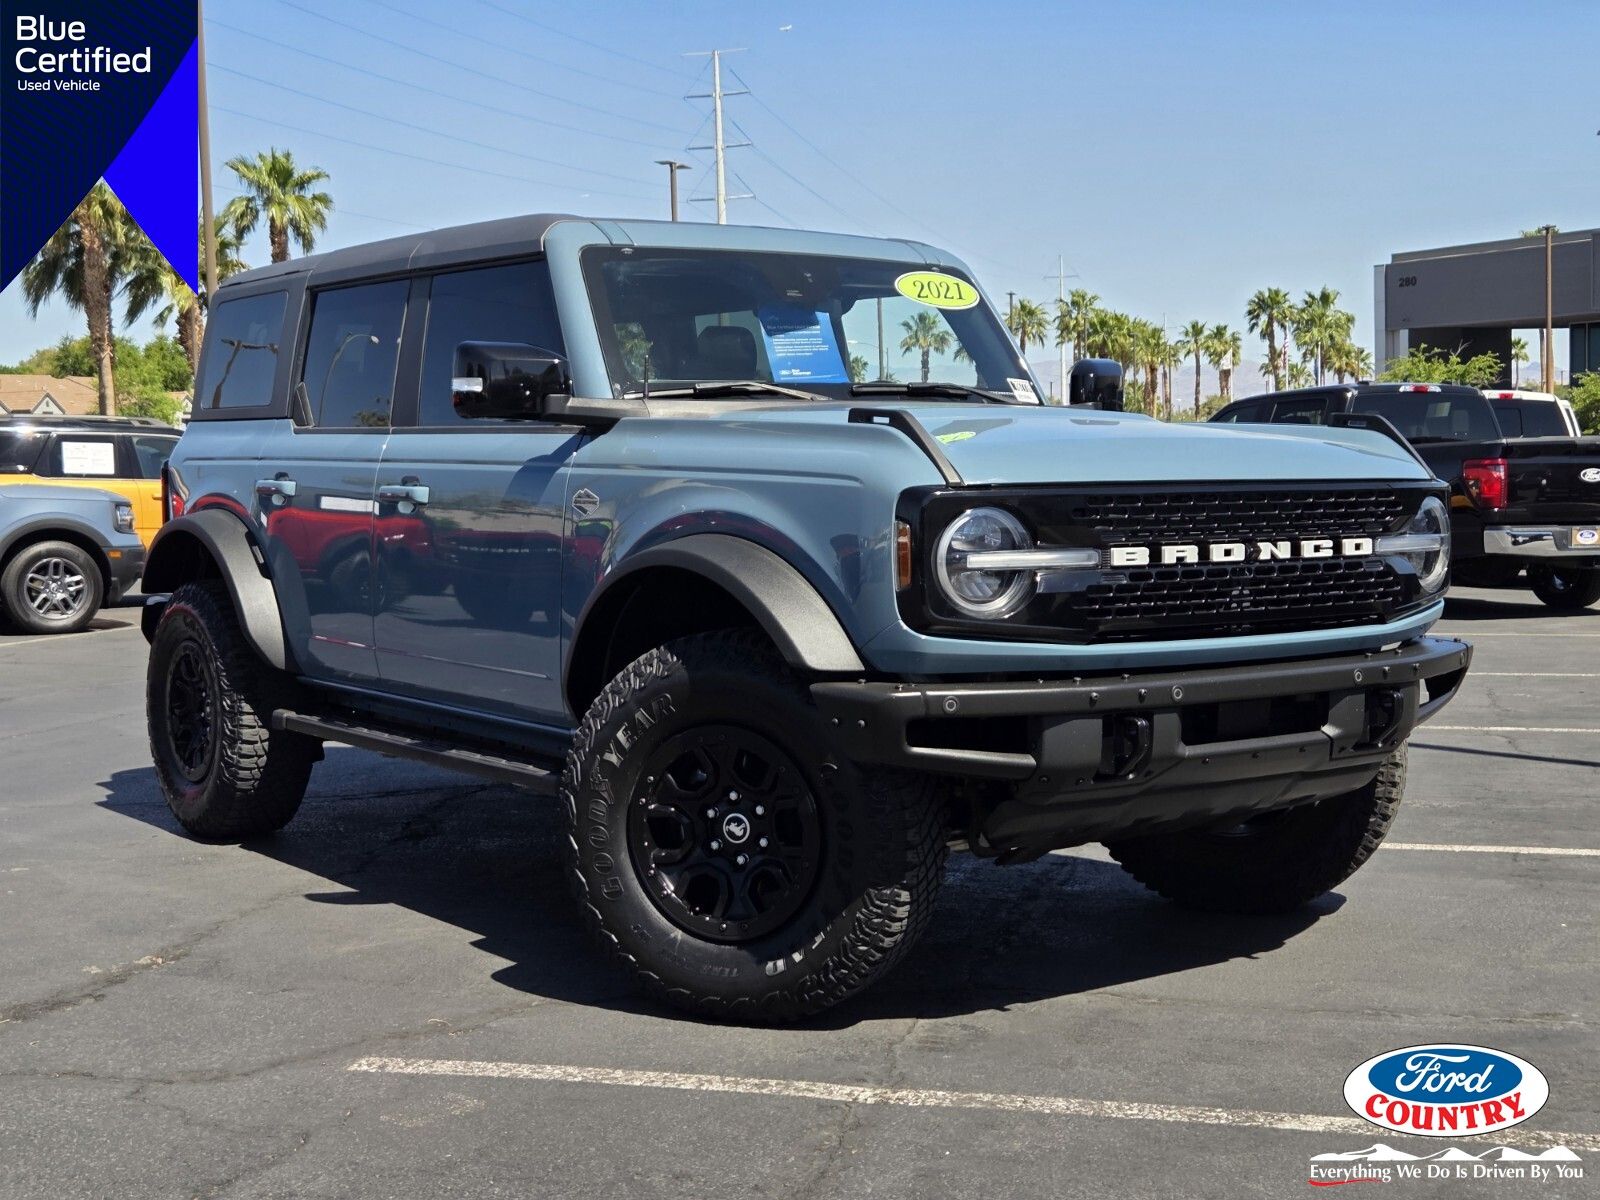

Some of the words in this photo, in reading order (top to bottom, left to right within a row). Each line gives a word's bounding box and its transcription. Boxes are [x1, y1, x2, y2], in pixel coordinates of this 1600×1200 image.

[912, 280, 967, 301] 2021
[1398, 276, 1418, 288] 280
[1110, 537, 1374, 567] BRONCO
